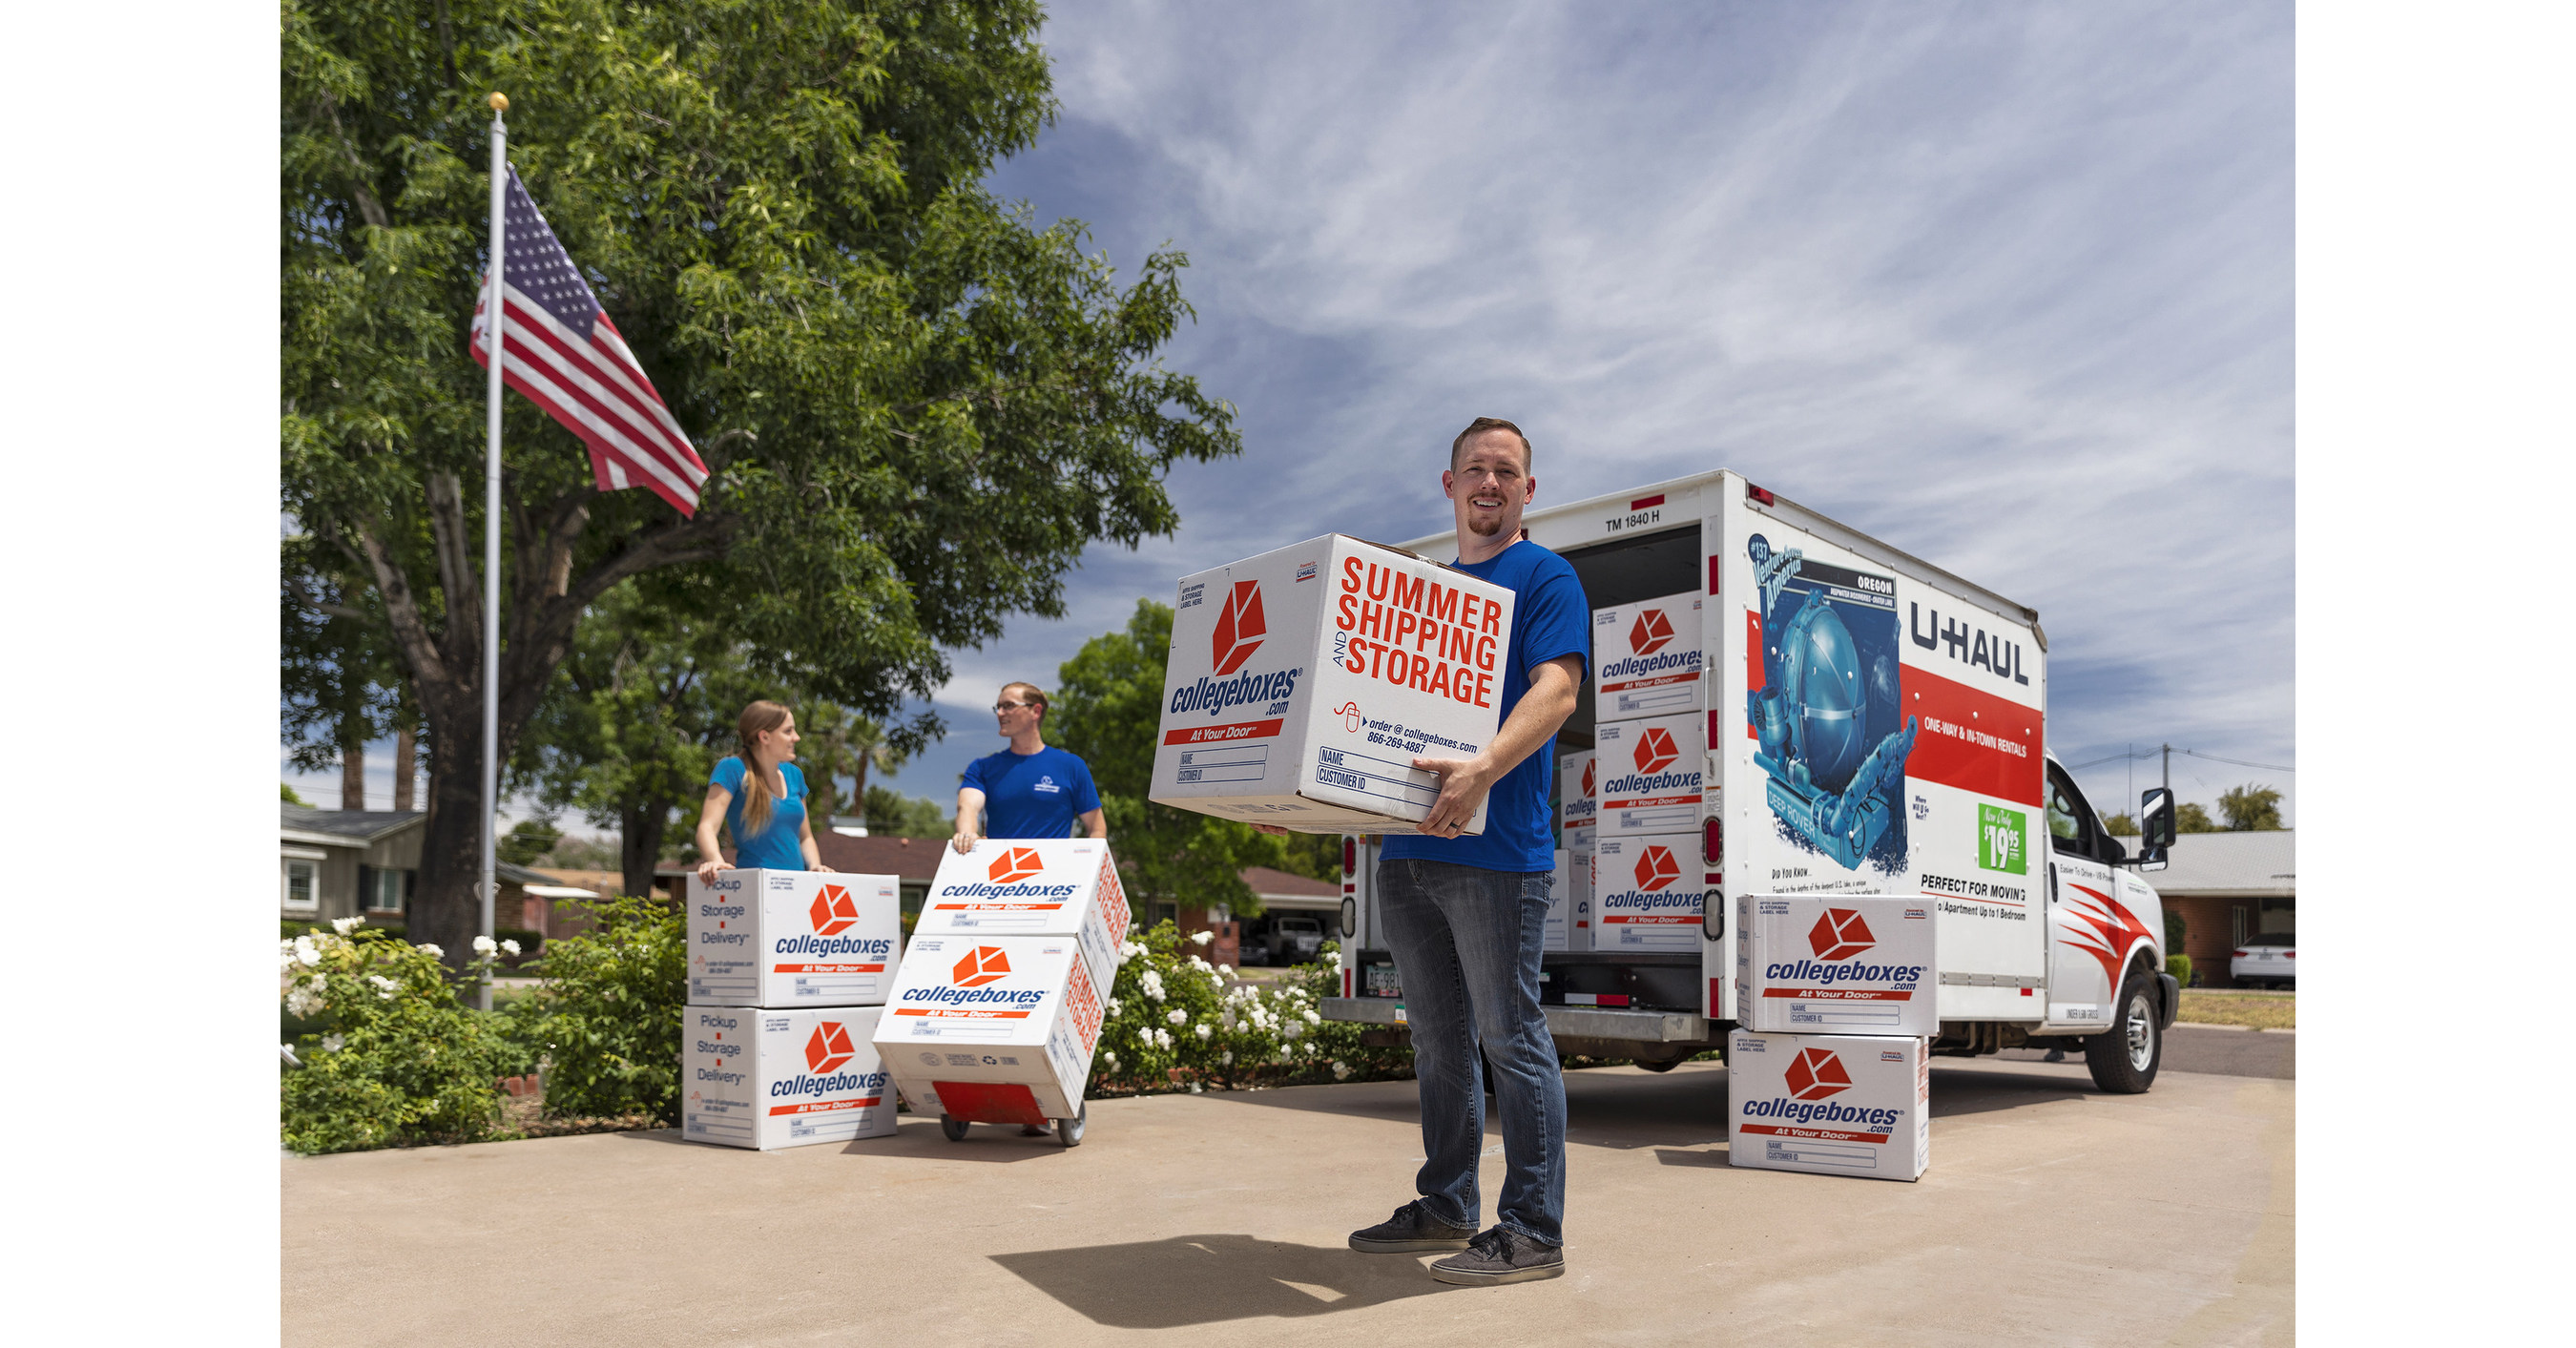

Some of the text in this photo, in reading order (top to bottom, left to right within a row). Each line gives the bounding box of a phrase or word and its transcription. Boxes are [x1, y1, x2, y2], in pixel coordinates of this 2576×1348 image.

[1606, 509, 1659, 532] TM 1840 H
[1750, 541, 1768, 561] #137
[1753, 551, 1784, 588] Venture
[1765, 558, 1802, 620] America
[1858, 575, 1892, 594] OREGON
[1180, 597, 1203, 609] LABEL HERE
[1185, 591, 1202, 601] STORAGE
[1341, 556, 1503, 637] SUMMER
[1336, 593, 1497, 672] SHIPPING
[1333, 631, 1347, 668] AND
[1910, 601, 2029, 687] U-HAUL
[1345, 637, 1494, 710] STORAGE
[1624, 677, 1674, 690] At Your Door
[1265, 700, 1289, 715] .com
[1190, 726, 1252, 741] At Your Door
[1367, 731, 1426, 755] 866-269-4887
[1369, 719, 1478, 754] order @ collegeboxes.com
[1924, 715, 2027, 758] ONE-WAY & IN-TOWN RENTALS
[1180, 753, 1193, 765] NAME
[1320, 749, 1344, 766] NAME
[1178, 769, 1198, 781] CUSTOMER
[1319, 767, 1366, 790] CUSTOMER ID
[1605, 771, 1702, 794] collegeboxe
[1768, 791, 1816, 839] DEEP ROVER
[1983, 807, 2012, 831] Now Only
[2060, 863, 2074, 875] Easier
[942, 882, 1077, 900] collegeboxes
[1921, 874, 2025, 902] PERFECT FOR MOVING
[1605, 889, 1702, 912] collegeboxe
[701, 903, 745, 920] Storage
[1938, 900, 1978, 916] o/Apartment
[1979, 905, 1987, 919] Up
[1988, 907, 1995, 918] to
[2000, 908, 2026, 922] Bedroom
[701, 931, 746, 946] Delivery
[776, 934, 891, 958] collegeboxes
[903, 985, 1046, 1006] collegeboxes
[1072, 952, 1102, 1033] SUMMER
[1798, 989, 1876, 999] At Your Door
[1890, 982, 1917, 990] .com
[700, 1014, 737, 1031] Pickup
[1066, 989, 1093, 1059] STORAGE
[696, 1040, 741, 1057] Storage
[697, 1068, 741, 1086] Delivery
[771, 1071, 886, 1097] collegeboxes
[1775, 1127, 1851, 1140] At Your Door
[1866, 1124, 1893, 1134] .com
[1768, 1141, 1782, 1150] NAME
[1768, 1151, 1794, 1161] CUSTOMER
